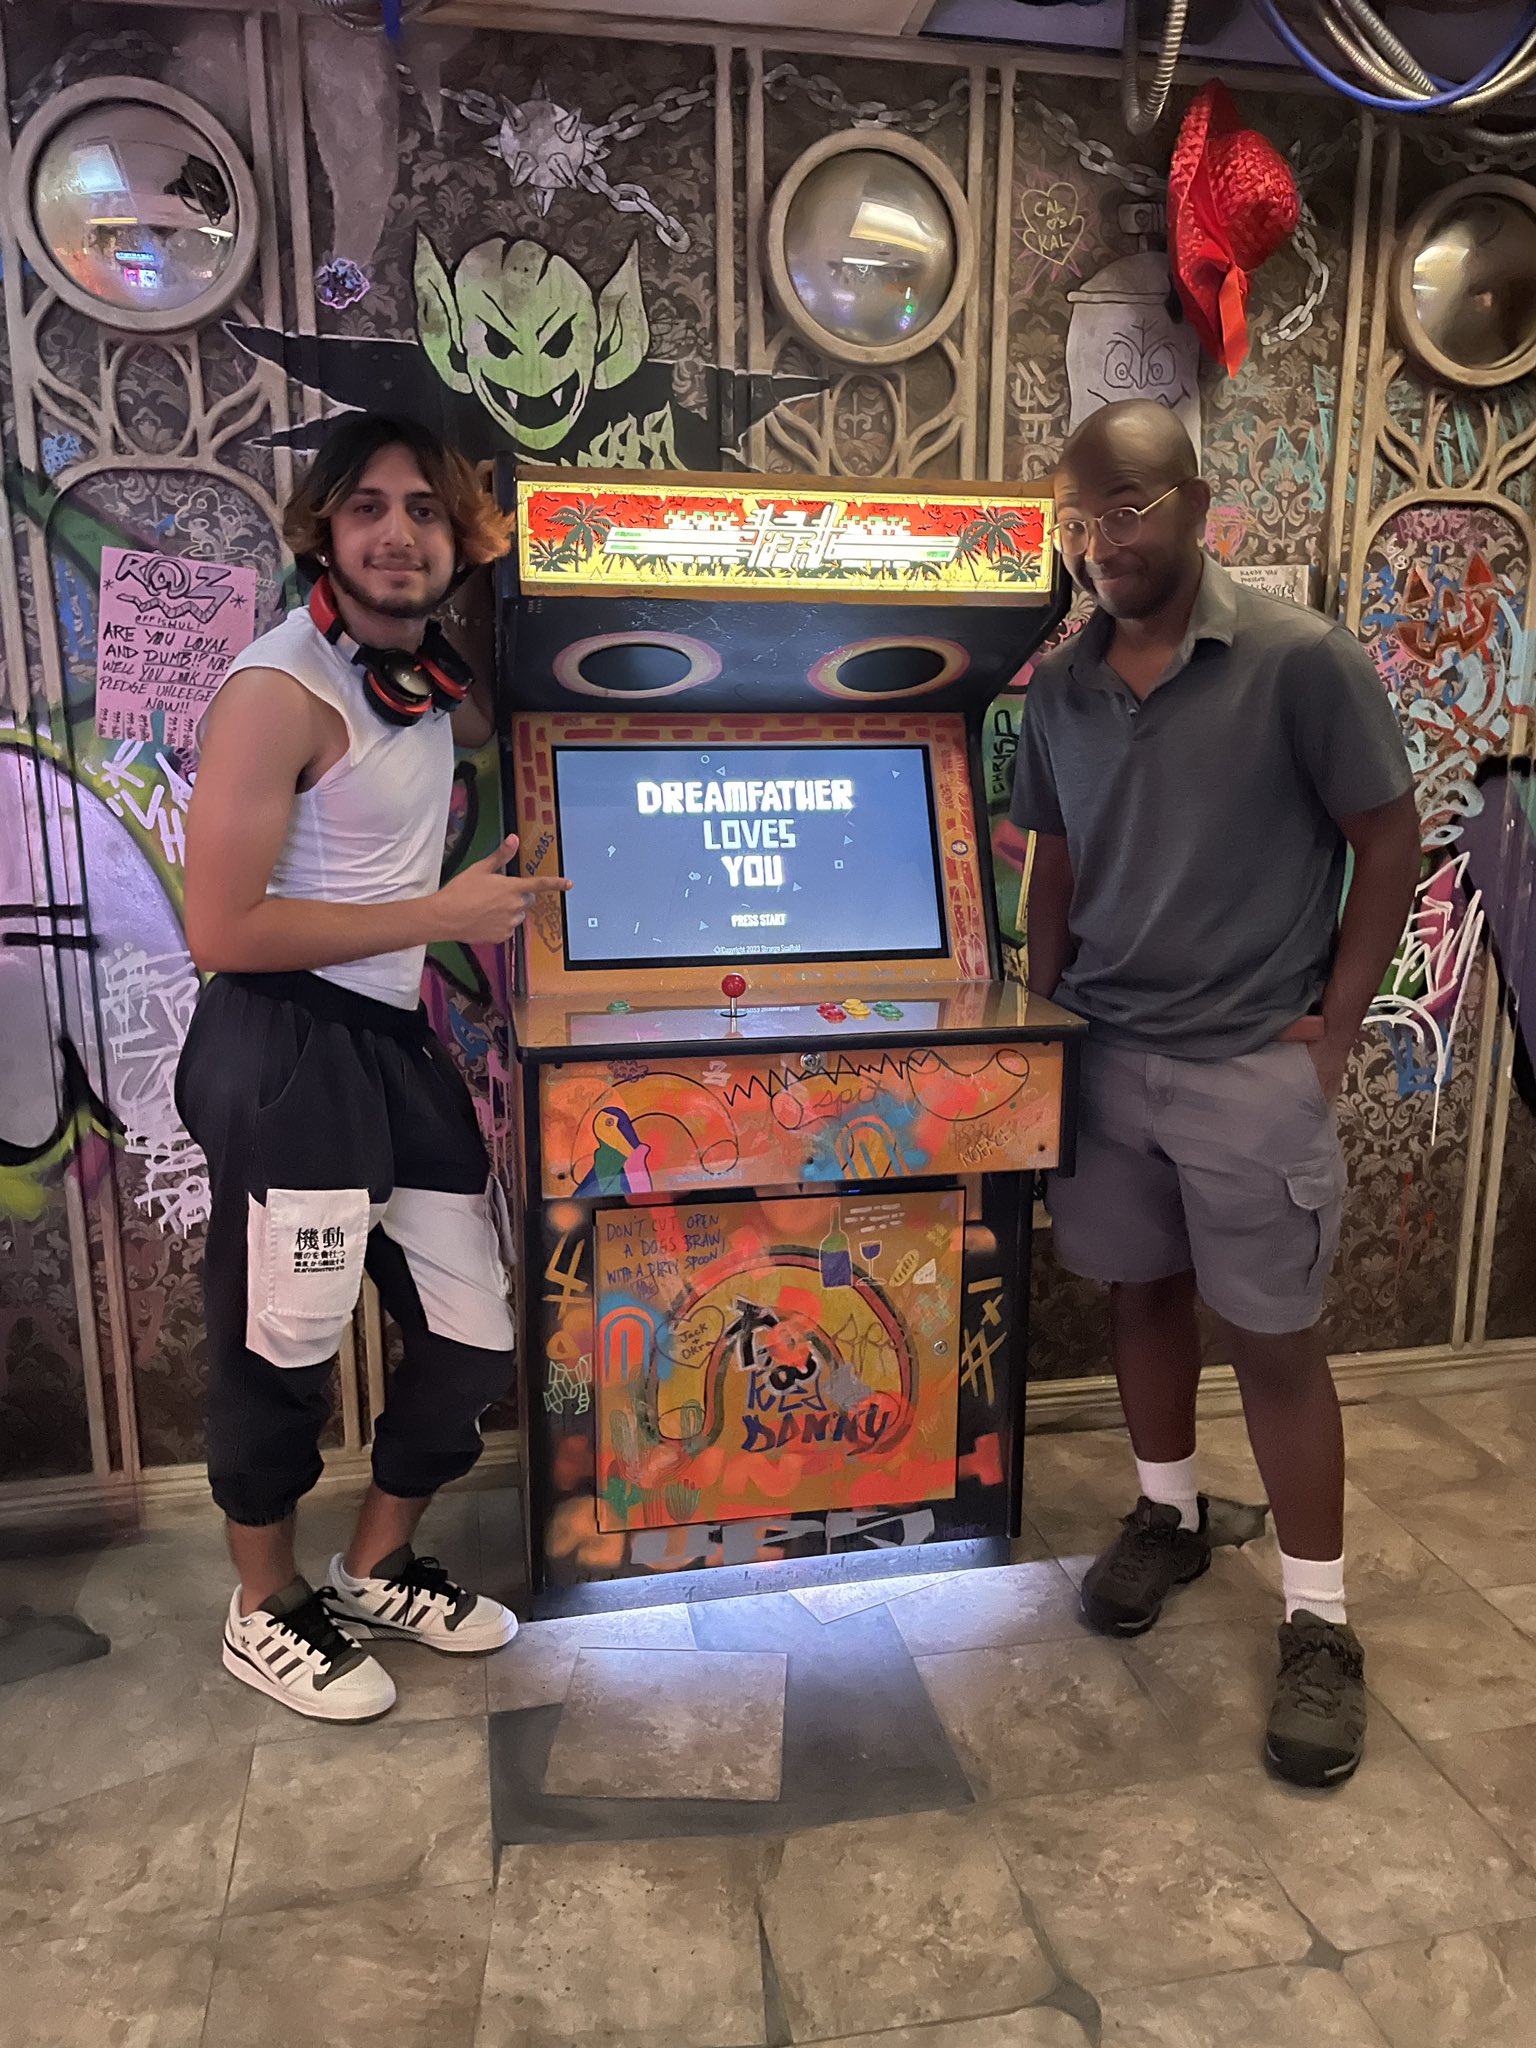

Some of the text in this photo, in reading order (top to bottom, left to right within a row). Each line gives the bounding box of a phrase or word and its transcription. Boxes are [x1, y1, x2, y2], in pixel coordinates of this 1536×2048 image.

[1034, 200, 1066, 217] CAL
[1038, 233, 1074, 254] KAL
[103, 621, 229, 651] ARE YOU LOYAL
[105, 644, 138, 659] AND
[144, 650, 209, 667] DUMB!?
[102, 660, 135, 675] WELL
[139, 664, 164, 681] YOU
[99, 676, 149, 695] PLEDGE
[145, 698, 190, 714] NOW!!
[636, 779, 855, 814] DREAMFATHER
[703, 819, 796, 849] LOVES
[721, 855, 784, 887] YOU
[731, 913, 786, 928] PRESS START
[687, 1213, 719, 1230] OPEN
[624, 1243, 633, 1258] A
[641, 1237, 677, 1256] DOGS
[636, 1262, 643, 1277] A
[646, 1259, 679, 1277] DIRTY
[678, 1323, 708, 1343] Jack
